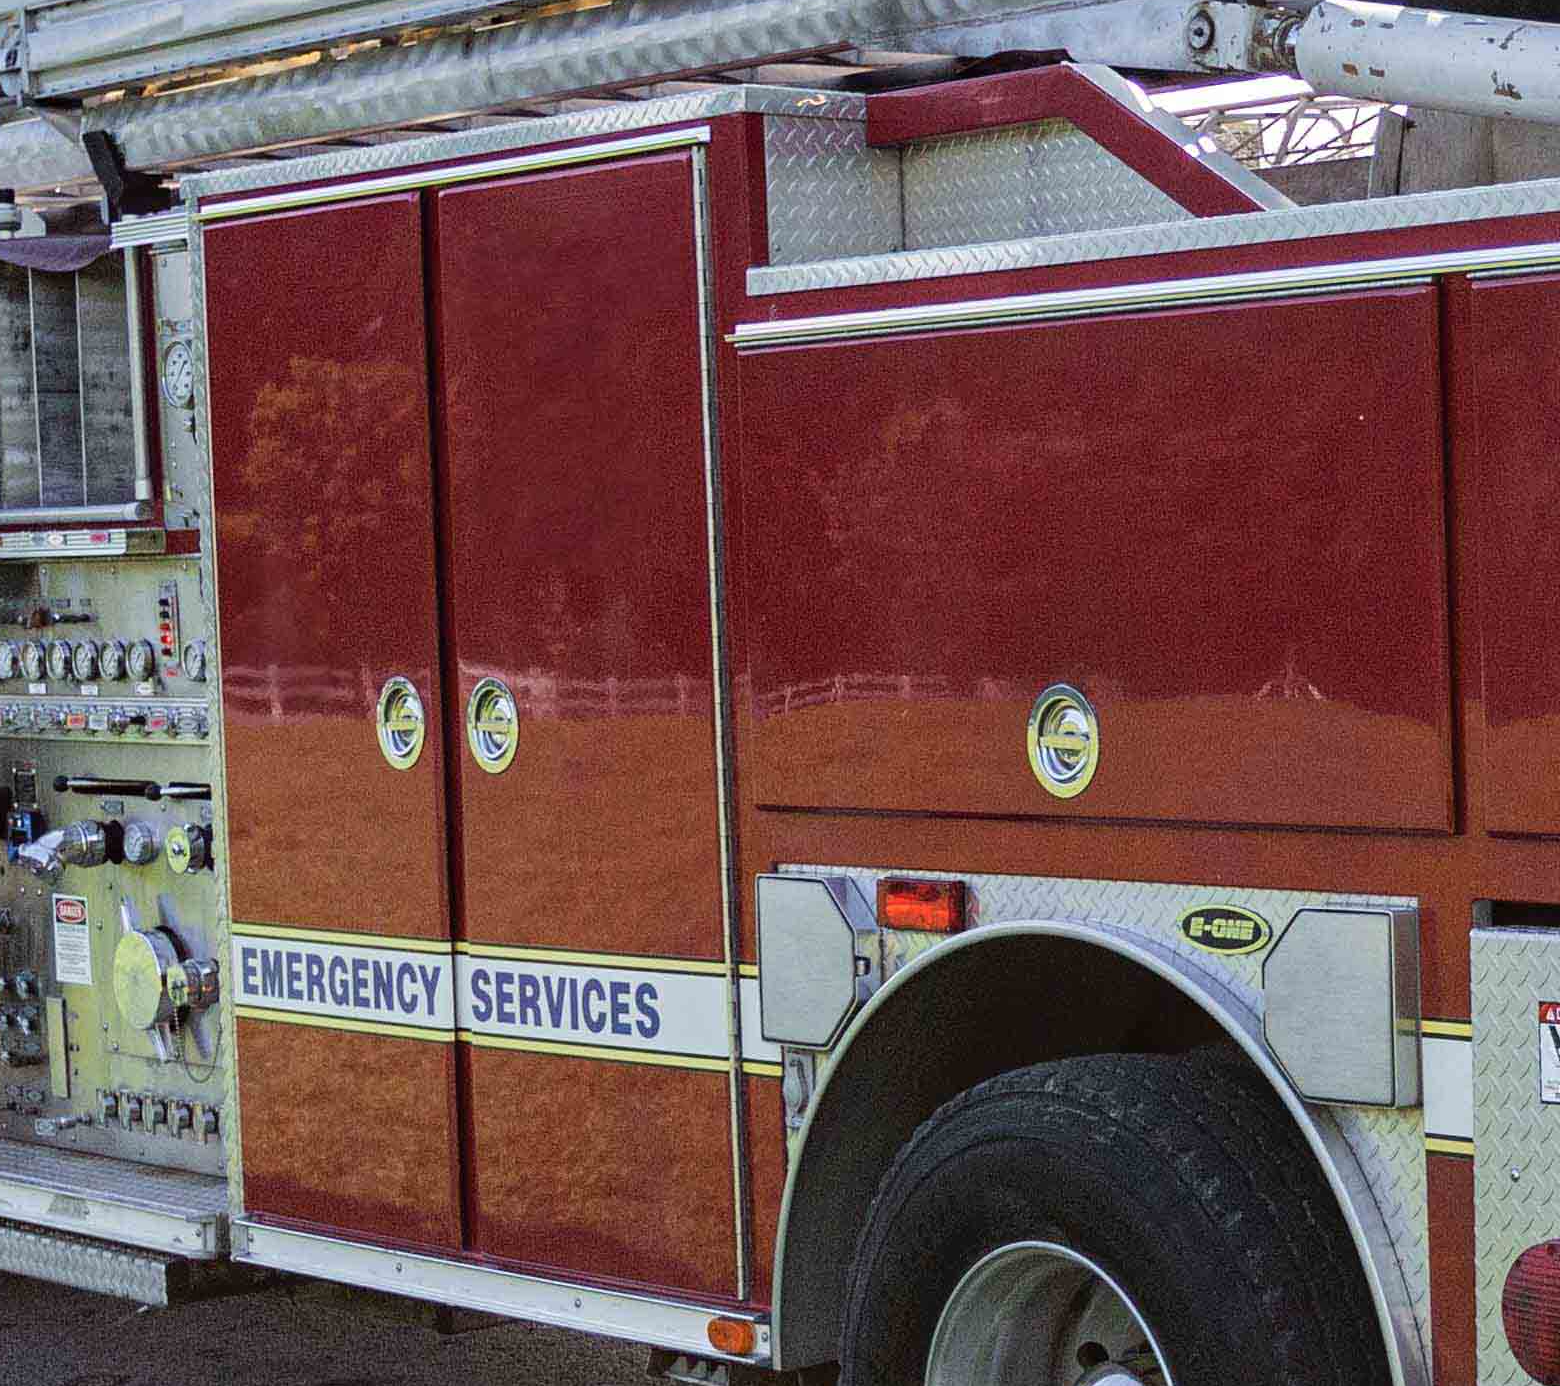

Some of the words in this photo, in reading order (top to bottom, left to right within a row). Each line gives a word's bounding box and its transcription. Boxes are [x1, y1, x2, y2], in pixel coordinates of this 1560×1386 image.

[1189, 916, 1255, 940] E-ONE
[240, 947, 441, 1016] EMERGENCY
[471, 968, 661, 1039] SERVICES
